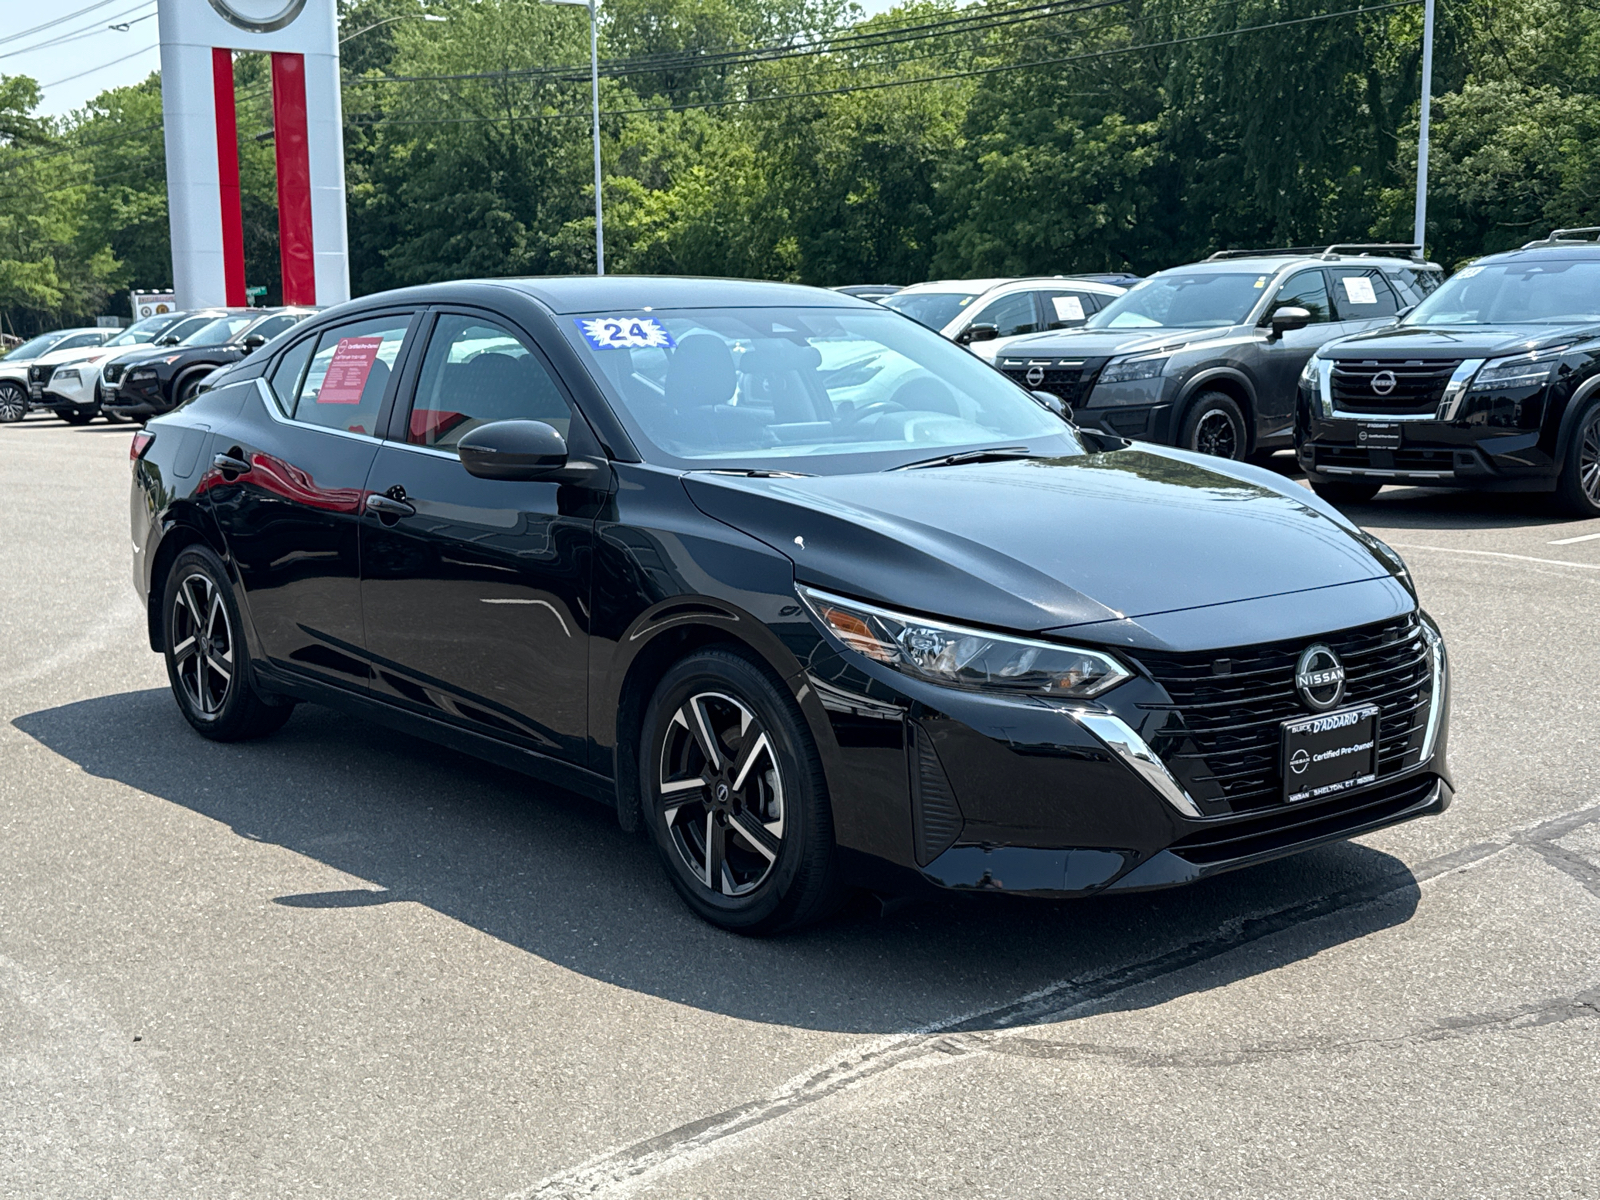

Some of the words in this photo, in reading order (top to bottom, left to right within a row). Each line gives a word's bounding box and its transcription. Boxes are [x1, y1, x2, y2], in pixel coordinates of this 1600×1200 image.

[603, 323, 648, 341] 24
[1299, 669, 1343, 686] NISSAN
[1291, 723, 1312, 734] BUICK
[1313, 713, 1358, 733] D'ADDARIO
[1312, 748, 1340, 762] Certified
[1340, 740, 1374, 756] Pre-Owned
[1289, 757, 1310, 766] NISSAN
[1289, 791, 1310, 802] NISSAN
[1345, 780, 1354, 788] CT
